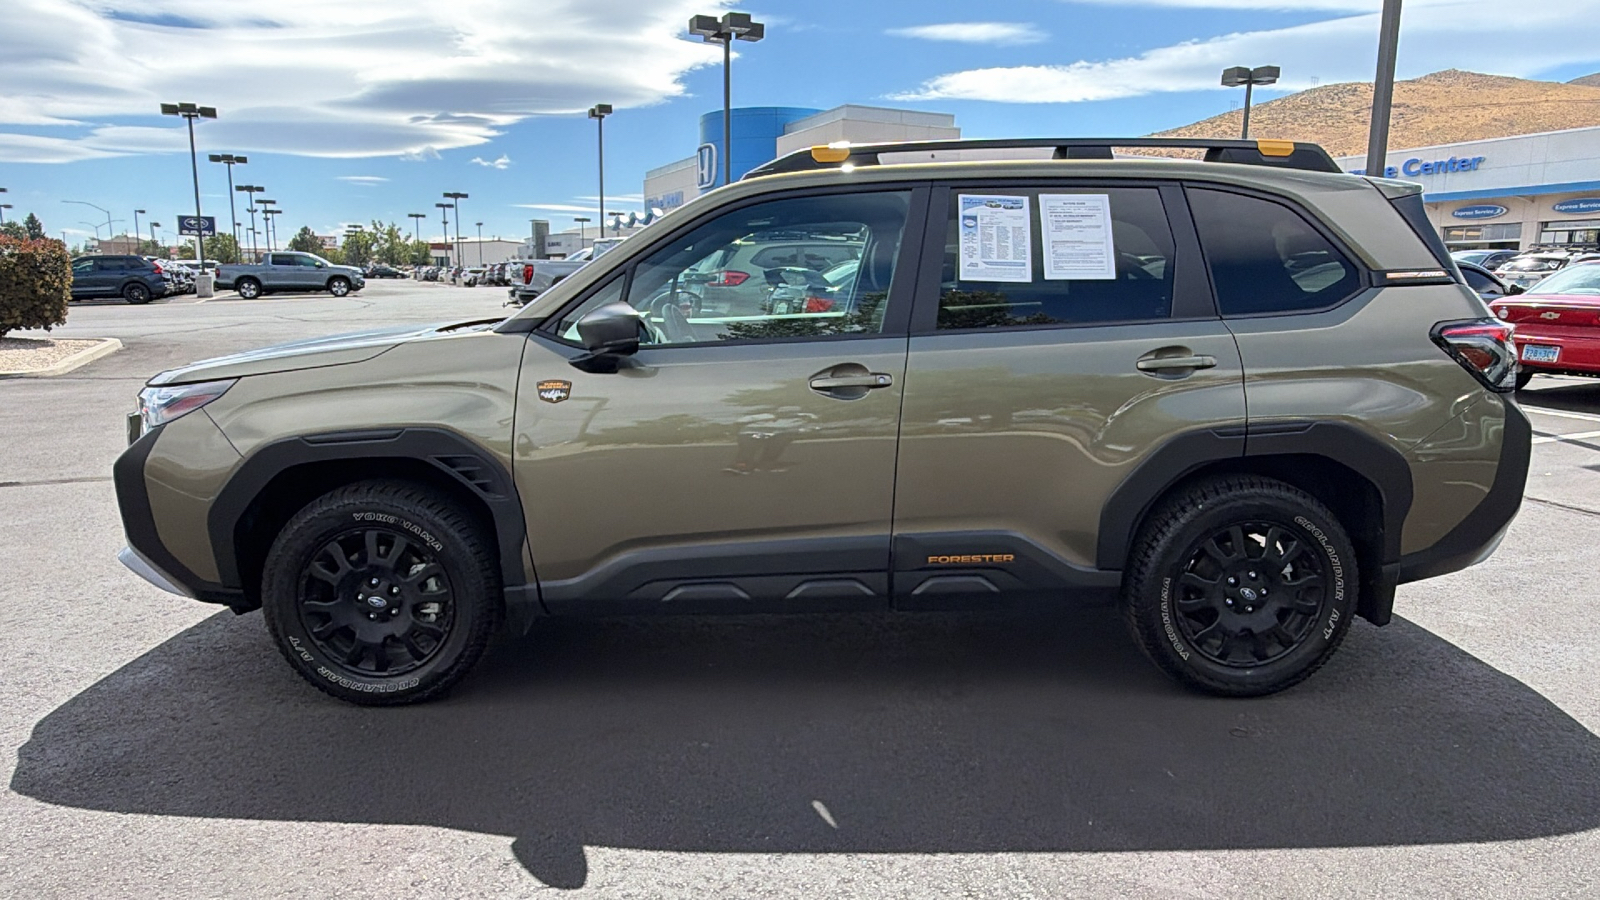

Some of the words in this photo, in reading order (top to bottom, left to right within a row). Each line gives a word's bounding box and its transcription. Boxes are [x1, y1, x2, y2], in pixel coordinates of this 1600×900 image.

[1402, 156, 1483, 177] Center
[1554, 204, 1578, 212] Express
[352, 512, 444, 552] YOKOHAMA
[927, 554, 1015, 564] FORESTER
[1294, 515, 1344, 601] GEOLANDAR
[1323, 608, 1340, 640] A/T
[1160, 577, 1190, 661] YOKOHAMA
[288, 635, 315, 662] A/T
[317, 666, 420, 693] GEOLANDAR
